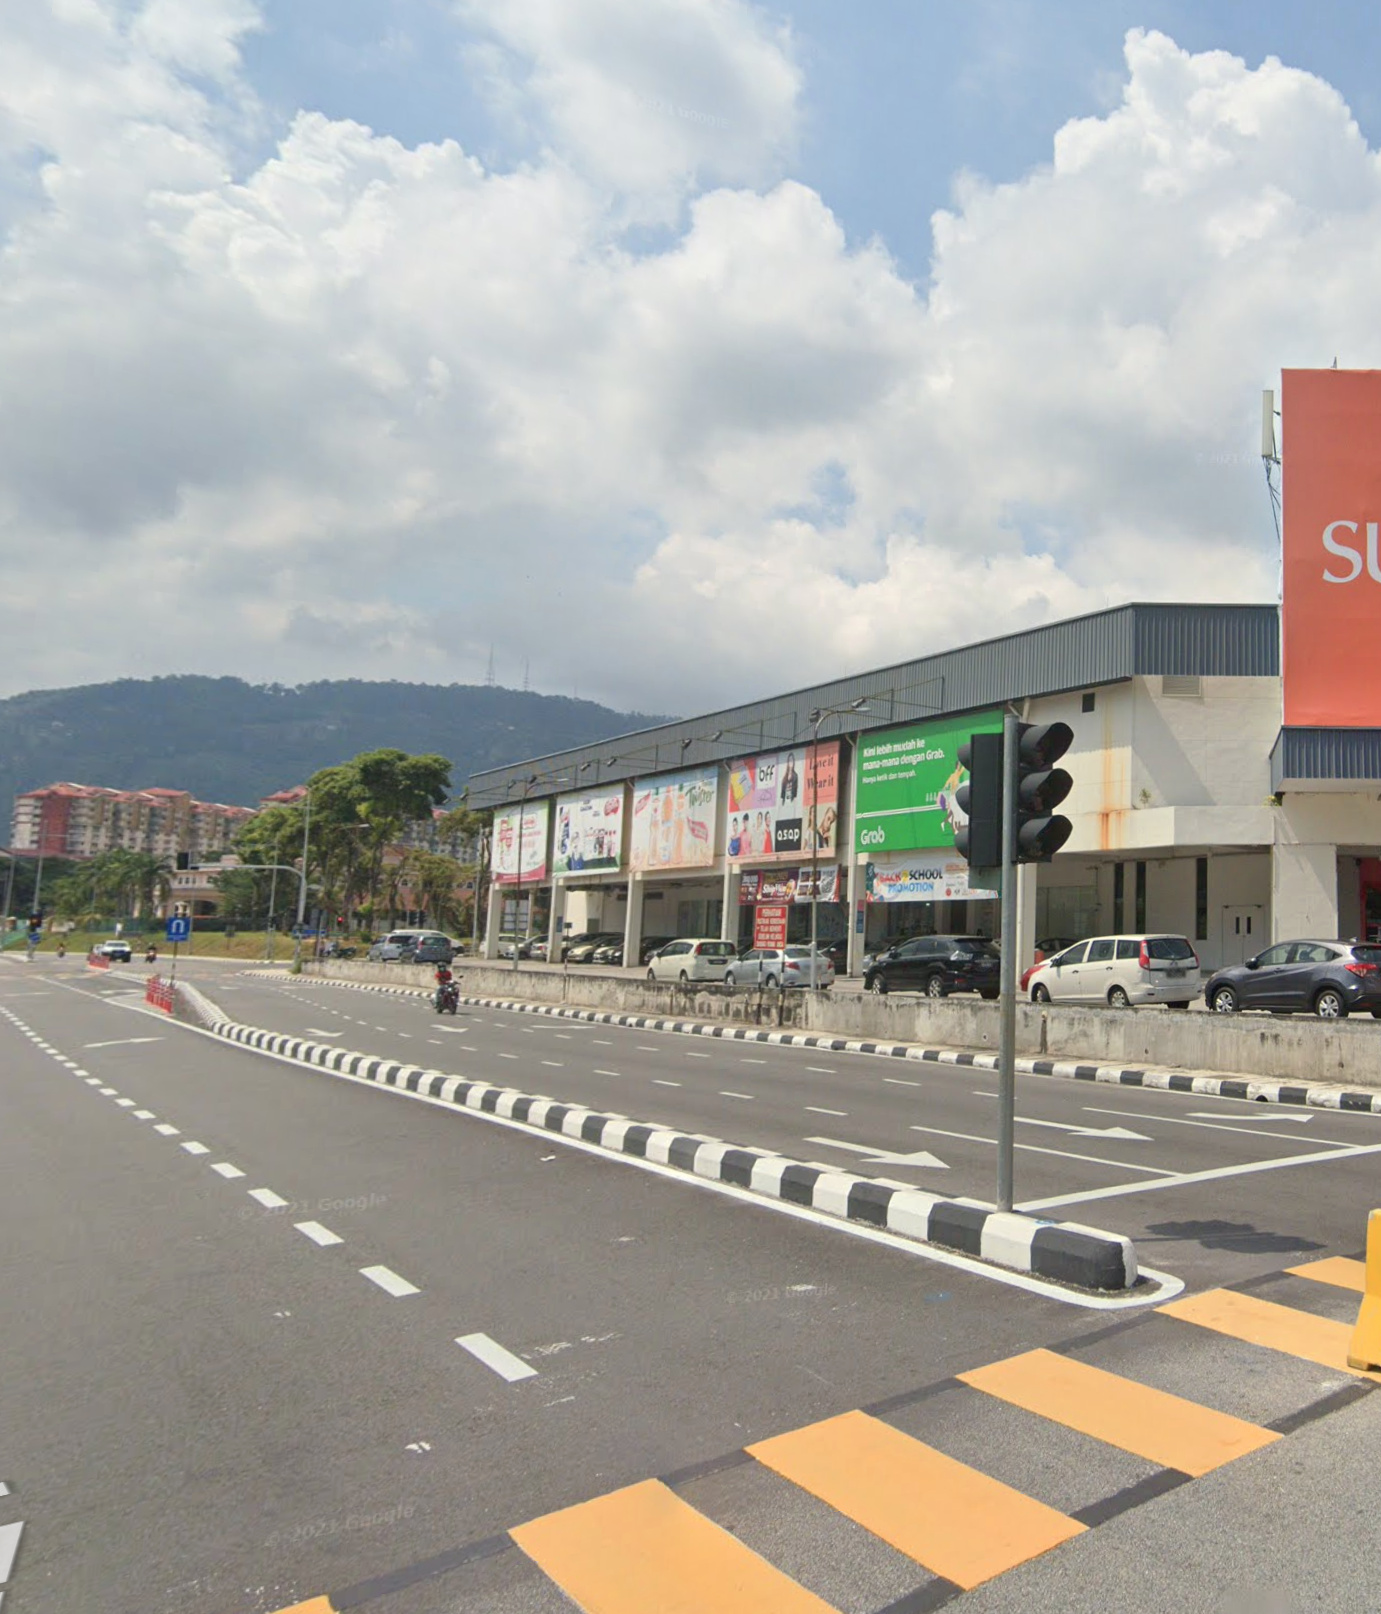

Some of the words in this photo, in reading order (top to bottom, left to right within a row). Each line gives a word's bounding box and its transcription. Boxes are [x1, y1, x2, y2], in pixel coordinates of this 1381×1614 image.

[916, 738, 926, 749] ke
[758, 764, 775, 782] bff
[860, 825, 885, 845] Grab
[909, 868, 943, 881] SCHOOL
[888, 881, 934, 893] PROMOTION
